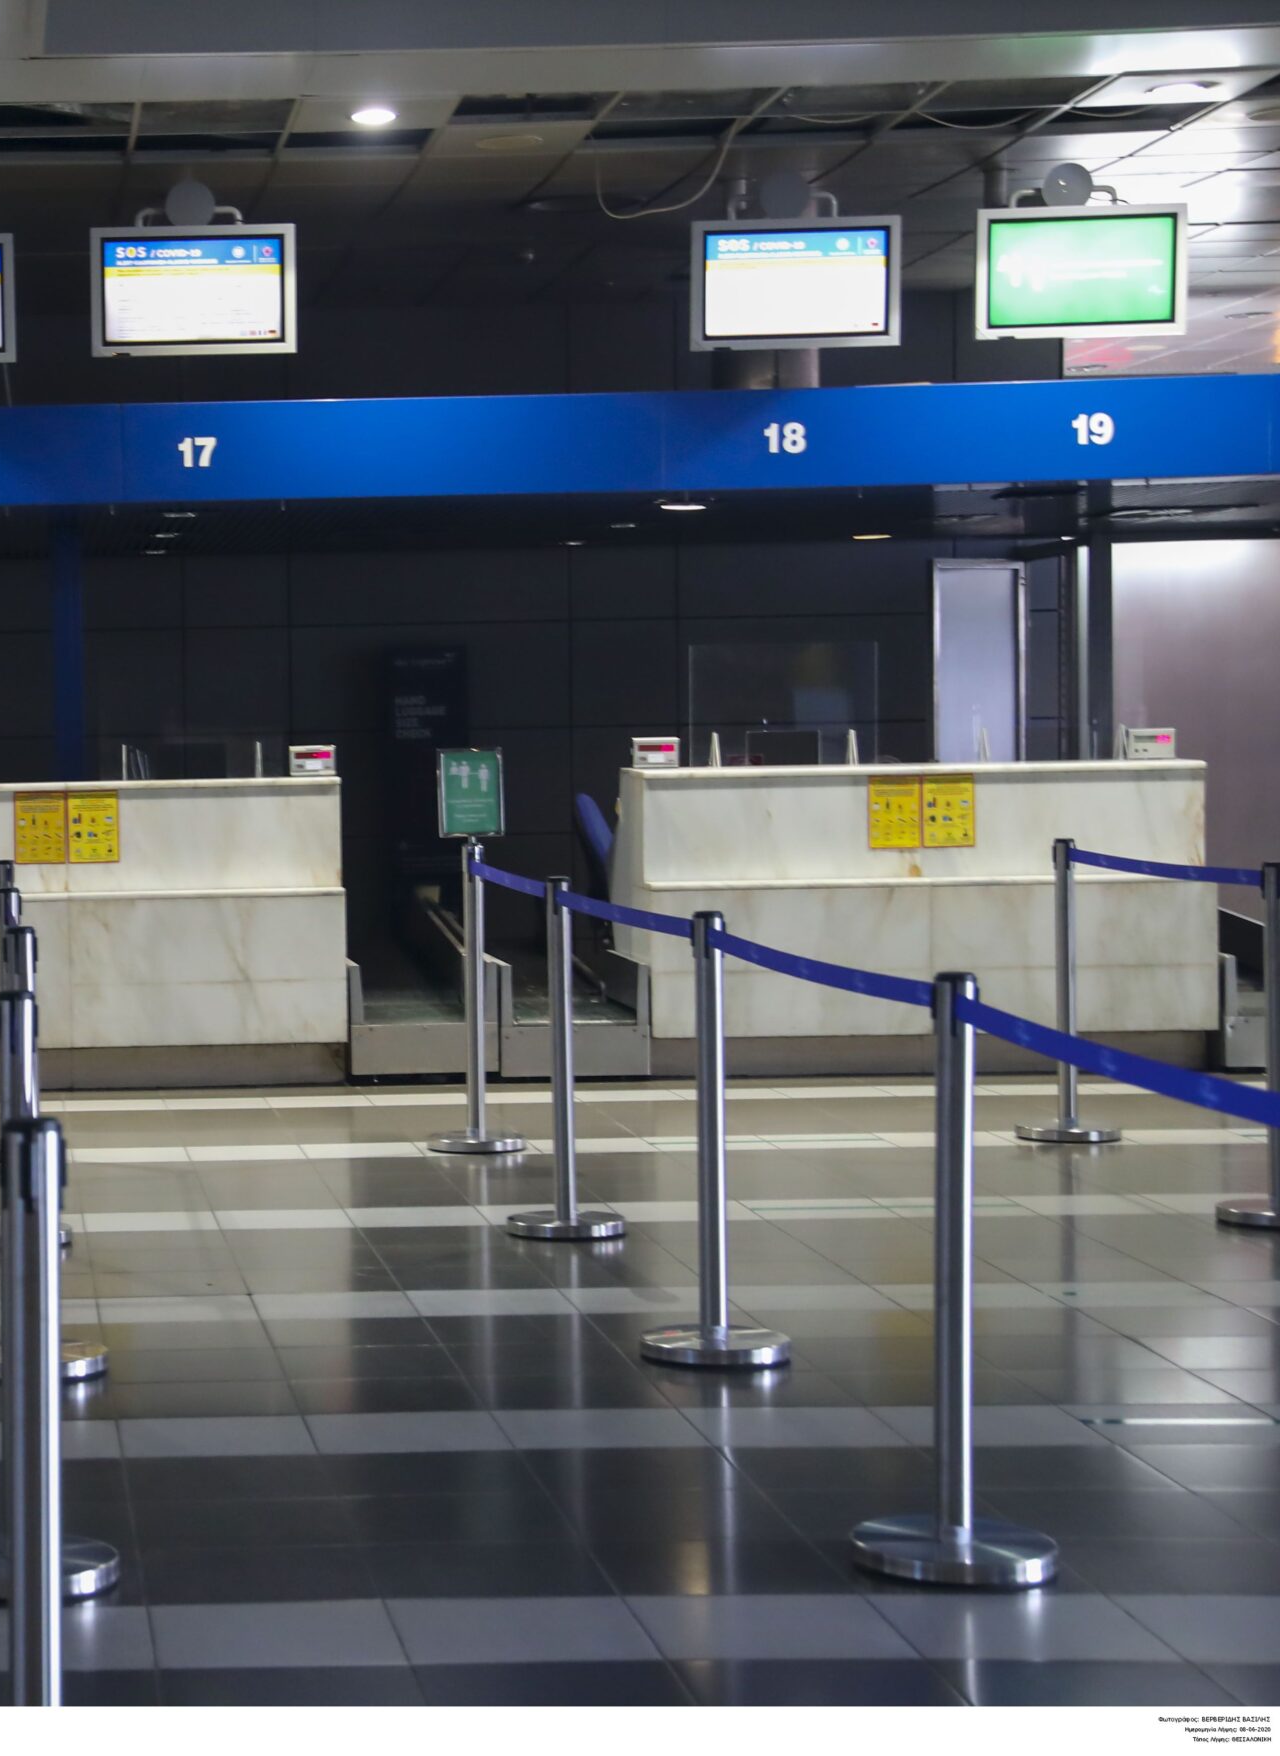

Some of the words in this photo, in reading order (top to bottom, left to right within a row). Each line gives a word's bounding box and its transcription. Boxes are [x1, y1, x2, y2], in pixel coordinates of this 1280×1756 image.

[116, 247, 146, 258] SOS
[764, 422, 807, 454] 18
[1072, 412, 1115, 445] 19
[178, 437, 217, 467] 17
